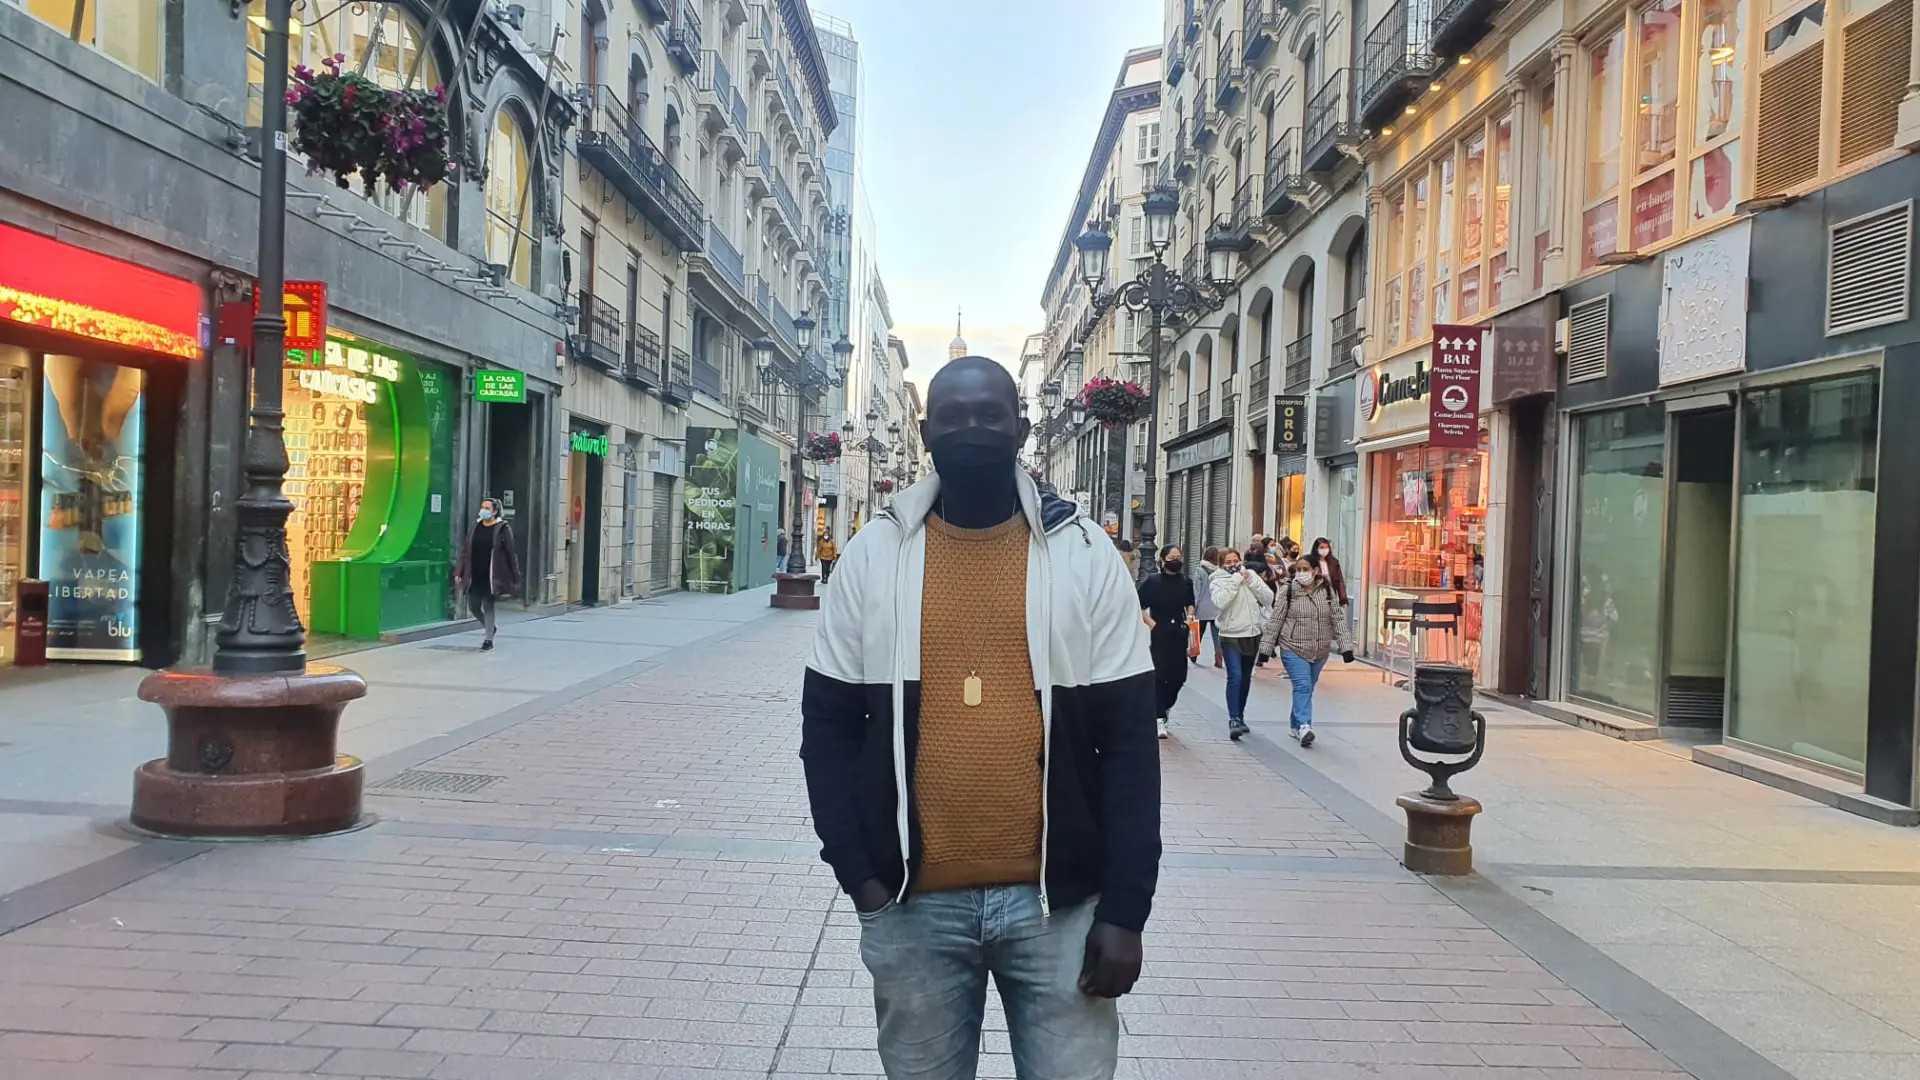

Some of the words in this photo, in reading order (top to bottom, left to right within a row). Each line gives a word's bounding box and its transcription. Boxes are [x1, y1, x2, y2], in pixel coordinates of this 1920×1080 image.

[1443, 353, 1471, 365] BAR
[372, 354, 398, 382] LAS
[483, 375, 494, 383] LA
[299, 369, 377, 404] CARCASAS
[480, 389, 519, 397] CARCASAS
[1283, 407, 1295, 441] ORO
[701, 487, 720, 496] TUS
[688, 498, 732, 508] PEDIDOS
[701, 510, 715, 518] EN
[687, 521, 693, 530] 2
[695, 521, 731, 531] HORAS
[73, 568, 129, 581] VAPEA
[48, 585, 129, 599] IBERTAD
[108, 620, 131, 638] blu
